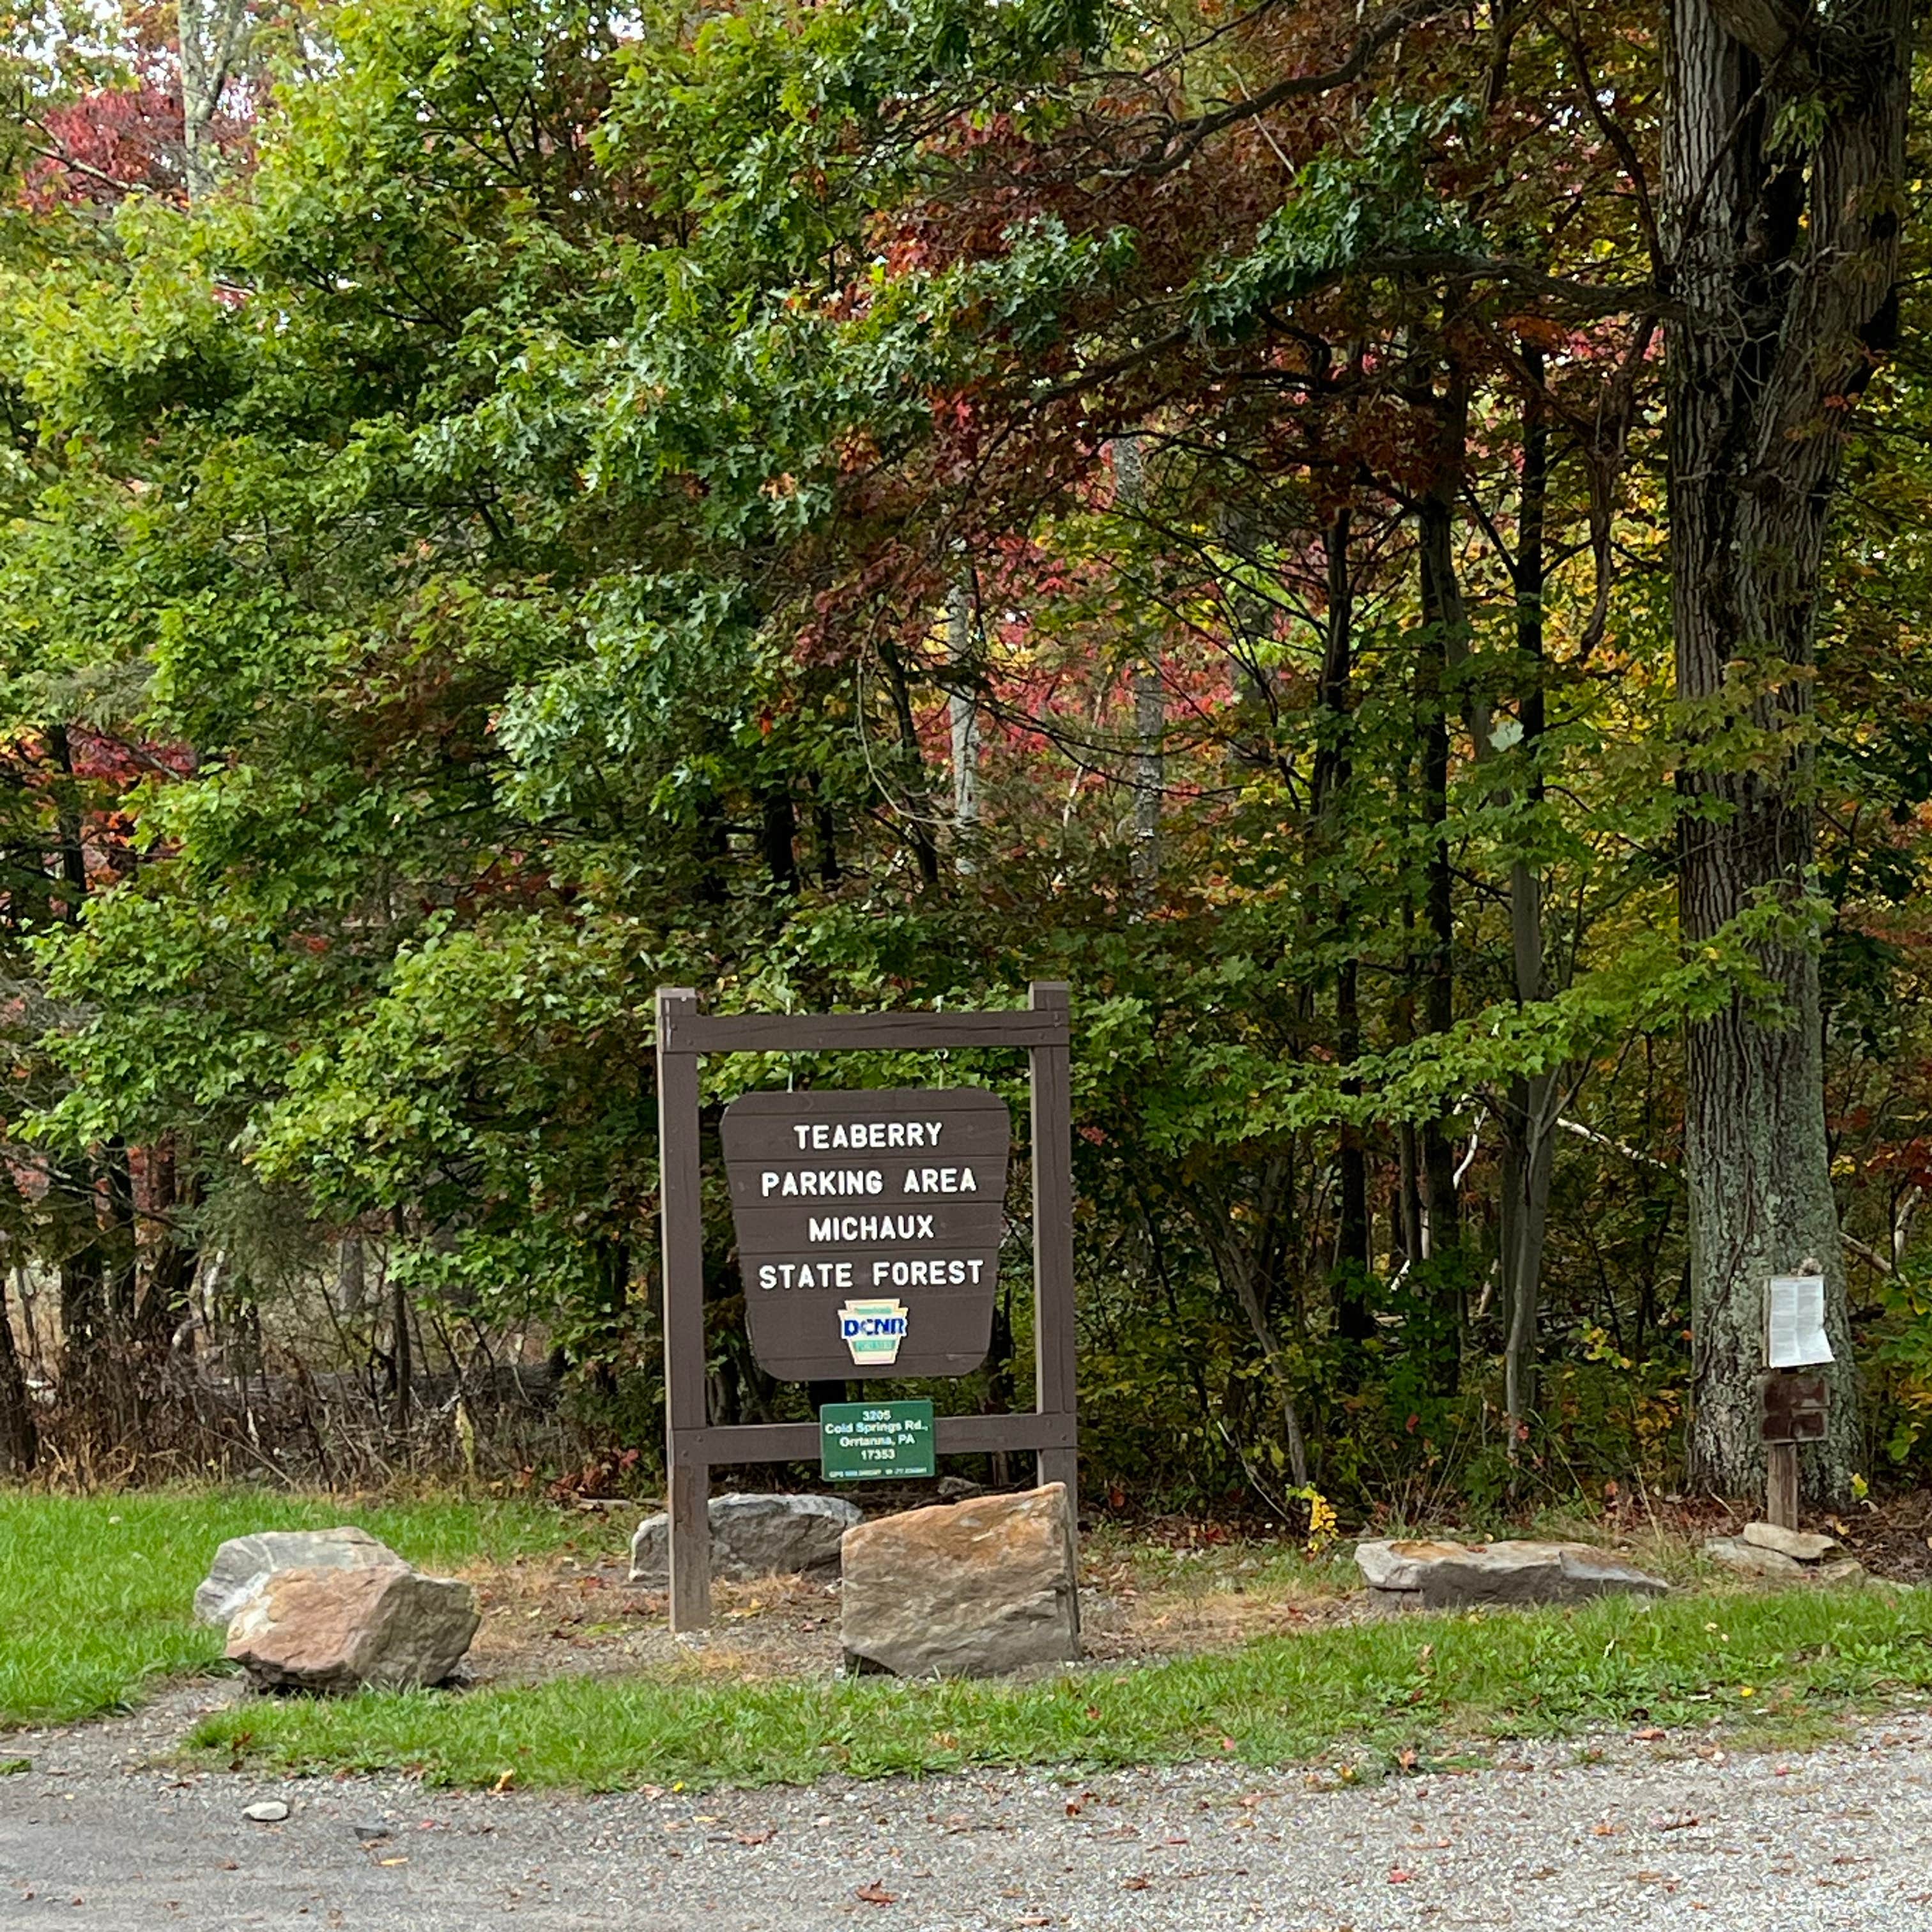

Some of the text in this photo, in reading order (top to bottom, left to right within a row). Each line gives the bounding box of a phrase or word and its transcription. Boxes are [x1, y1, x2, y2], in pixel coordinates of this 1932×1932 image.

[793, 1123, 942, 1149] TEABERRY
[762, 1168, 977, 1197] PARKING AREA
[809, 1215, 934, 1242] MICHAUX
[759, 1259, 983, 1289] STATE FOREST
[844, 1318, 905, 1337] DCNR
[862, 1410, 891, 1421] 3205
[825, 1423, 854, 1434] Cold
[856, 1422, 901, 1434] Springs
[898, 1434, 915, 1445] PA
[861, 1448, 895, 1460] 17353
